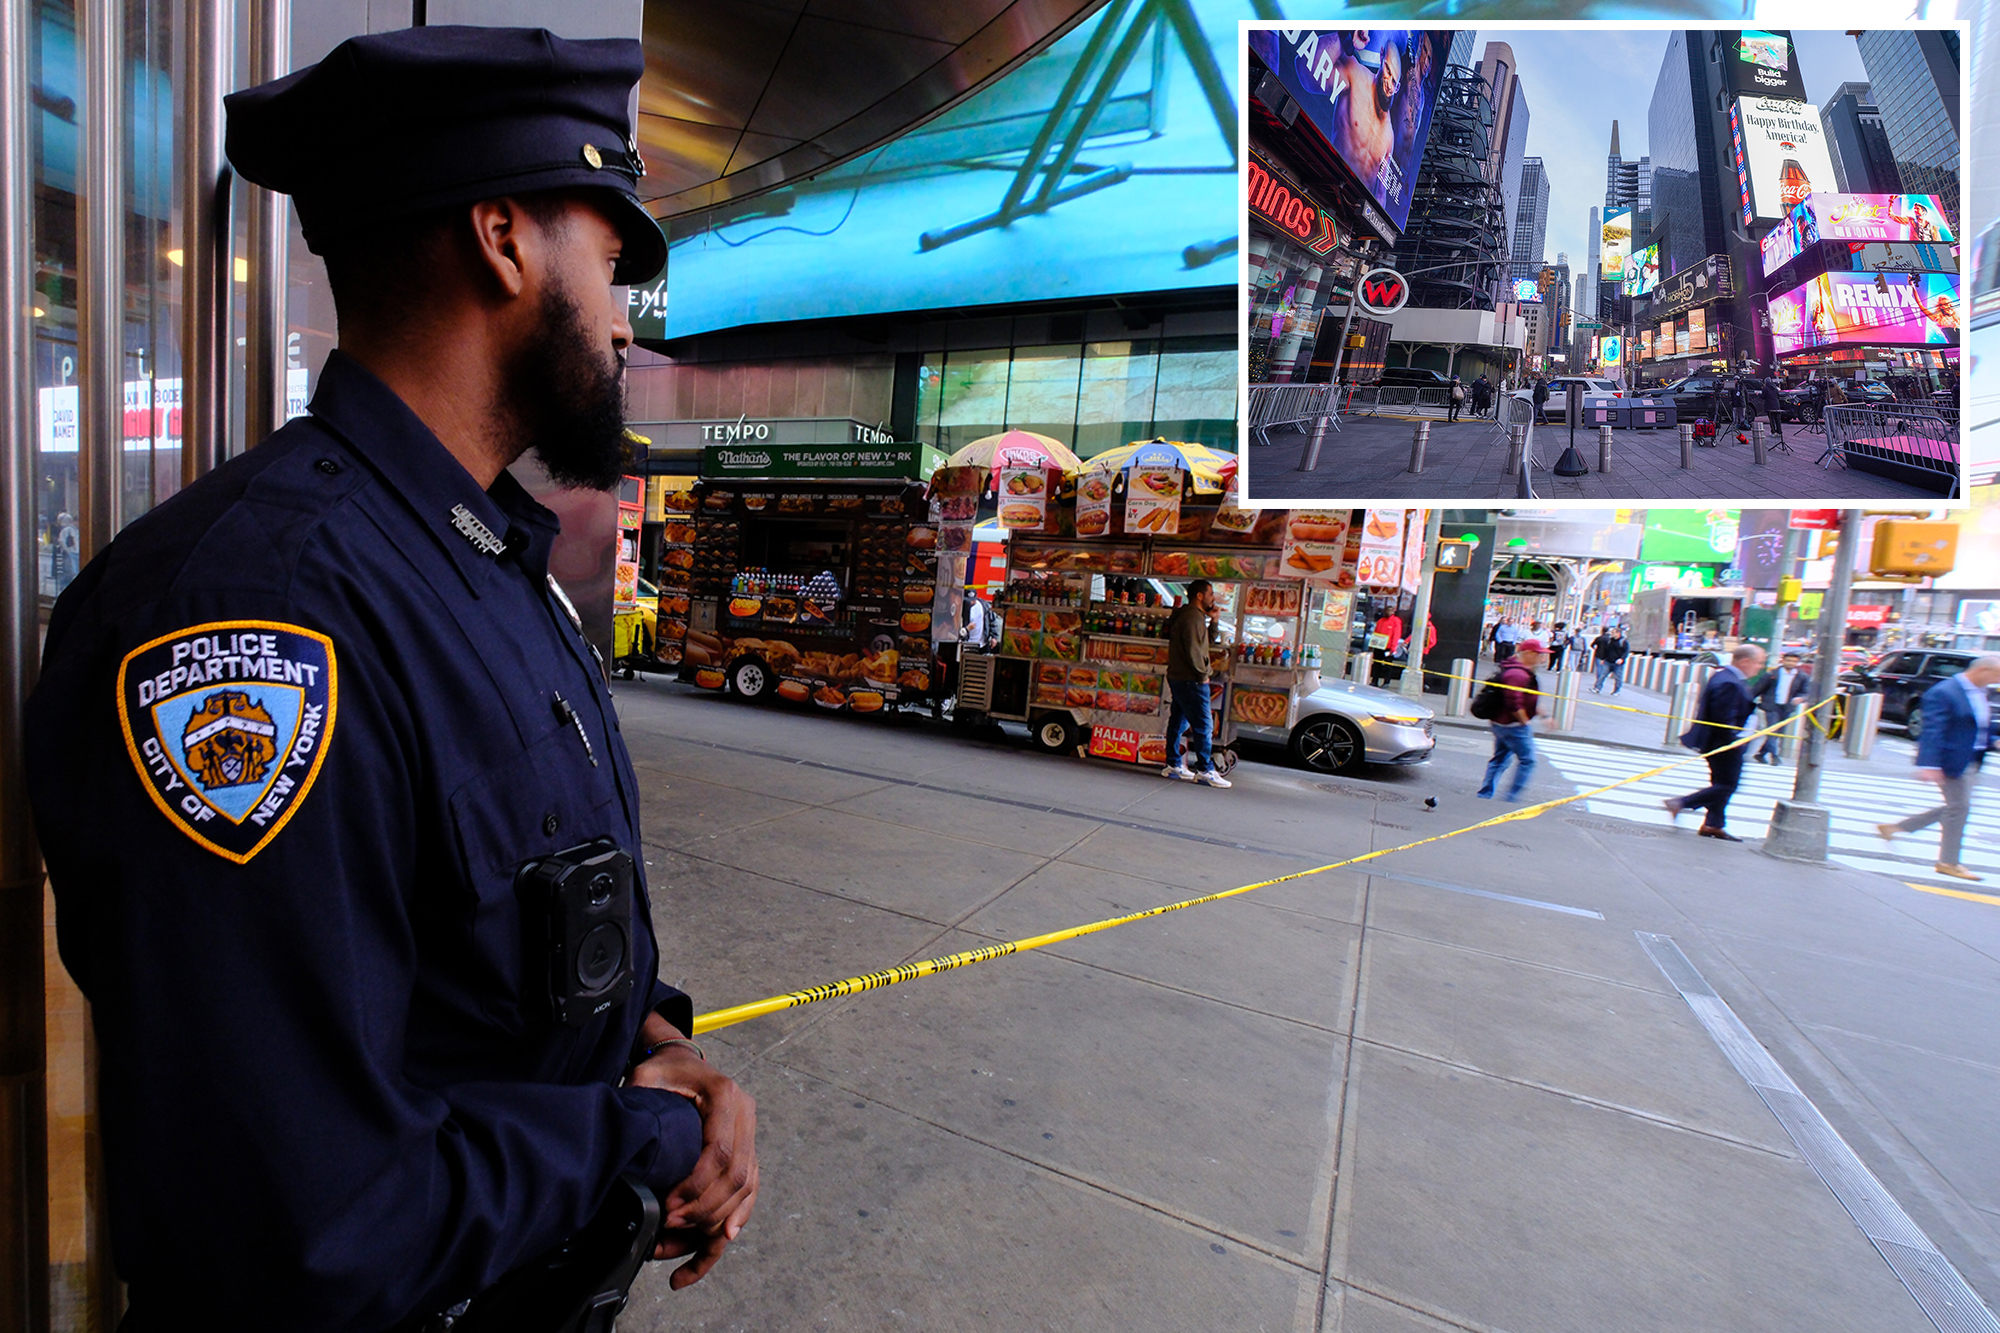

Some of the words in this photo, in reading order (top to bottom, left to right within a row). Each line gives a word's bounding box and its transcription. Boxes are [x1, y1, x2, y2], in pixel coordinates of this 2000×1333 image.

[1754, 75, 1788, 87] bigger
[1757, 68, 1782, 78] Build
[1746, 114, 1776, 130] Happy
[1778, 117, 1820, 134] Birthday,
[1765, 129, 1808, 144] America!
[1365, 280, 1402, 308] W
[1667, 286, 1692, 303] MORMON
[1678, 270, 1695, 302] 15
[1836, 283, 1917, 308] REMIX
[702, 416, 769, 443] TEMPO
[718, 450, 772, 467] Nathan's
[783, 453, 801, 461] THE
[803, 453, 839, 461] FLAVOR
[842, 452, 855, 461] OF
[857, 452, 882, 461] NEW
[451, 503, 507, 555] MIDTOWN
[451, 516, 491, 553] NORTH
[172, 634, 278, 667] POLICE
[138, 656, 319, 708] DEPARTMENT
[1094, 727, 1136, 744] HALAL
[1093, 740, 1132, 756] حلال
[251, 774, 296, 827] NEW
[287, 702, 323, 767] YORK
[142, 736, 185, 792] CITY
[181, 795, 216, 822] OF
[593, 1000, 611, 1015] AXON
